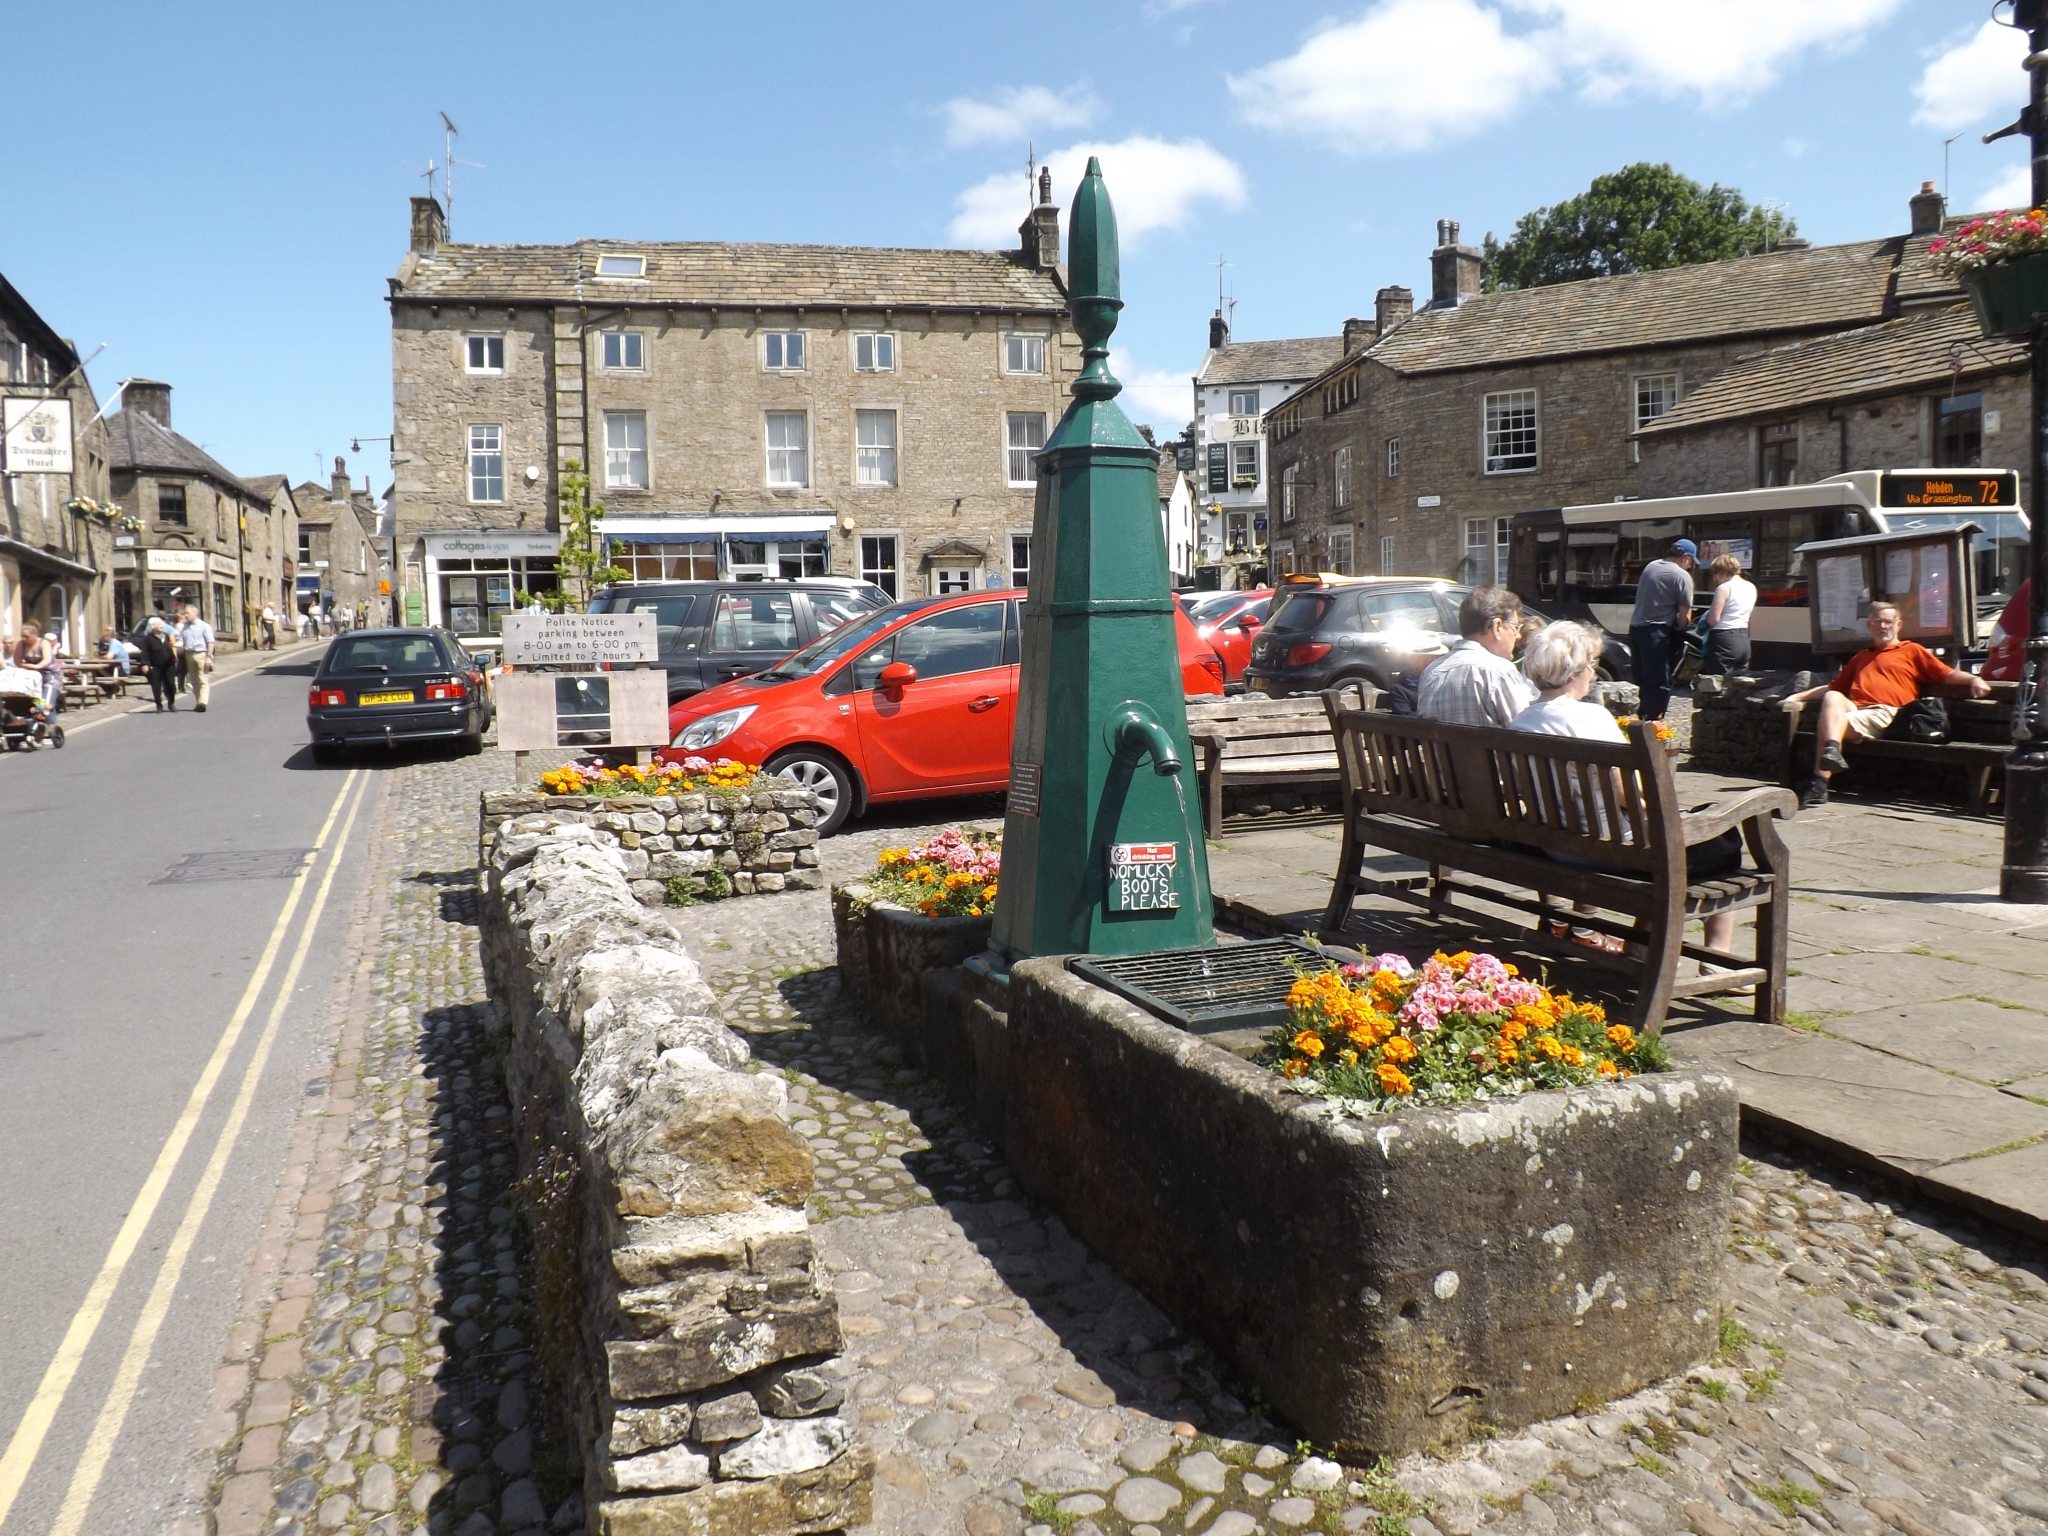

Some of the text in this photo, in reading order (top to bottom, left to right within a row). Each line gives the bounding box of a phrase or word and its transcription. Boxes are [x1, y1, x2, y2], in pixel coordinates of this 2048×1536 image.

[12, 446, 68, 457] Devonshire
[27, 459, 54, 467] Hotel
[1926, 481, 1954, 494] Hebden
[1980, 480, 1999, 504] 72
[1907, 494, 1973, 505] Via Grassington
[545, 618, 615, 627] Polite Notice
[538, 628, 625, 639] parking between
[524, 641, 552, 650] 8-00
[577, 641, 587, 649] to
[592, 640, 620, 649] 6-00
[624, 641, 639, 650] pm
[532, 653, 571, 661] Limited
[591, 652, 598, 660] 2
[603, 651, 631, 660] hours
[364, 694, 389, 703] DF52
[1121, 877, 1169, 895] BOOTS
[1121, 892, 1181, 911] PLEASE
